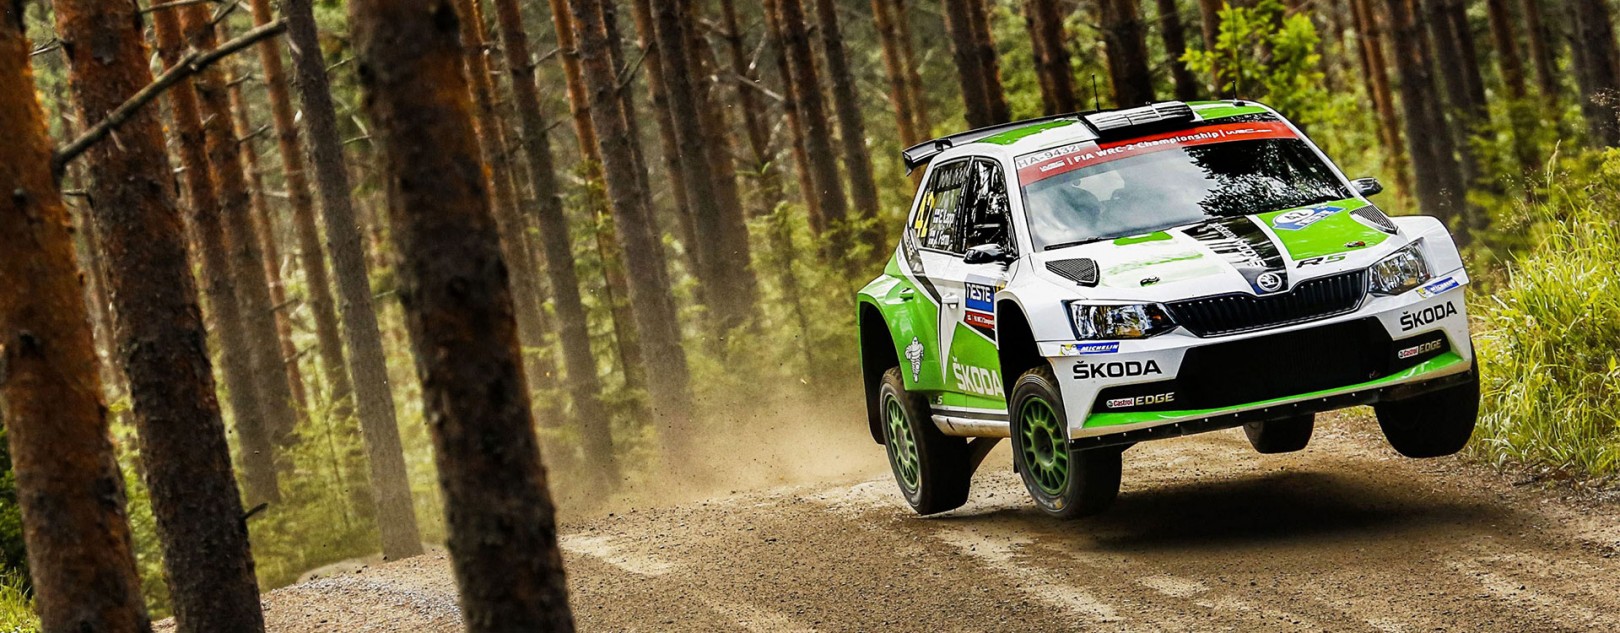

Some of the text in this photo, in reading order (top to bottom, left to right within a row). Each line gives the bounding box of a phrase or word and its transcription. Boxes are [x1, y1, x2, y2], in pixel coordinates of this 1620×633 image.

[1017, 144, 1078, 168] HA-9432
[1073, 153, 1095, 163] FIA
[1096, 141, 1134, 157] WRC-2
[1136, 130, 1219, 148] Championship
[1296, 254, 1346, 268] R5
[966, 283, 991, 303] NESTE
[1400, 301, 1457, 331] ŠKODA
[1080, 343, 1119, 352] MICHELIN
[1419, 339, 1442, 354] EDGE
[952, 356, 1005, 397] ŠKODA
[1072, 360, 1162, 379] ŠKODA
[1113, 392, 1175, 407] Castrol EDGE
